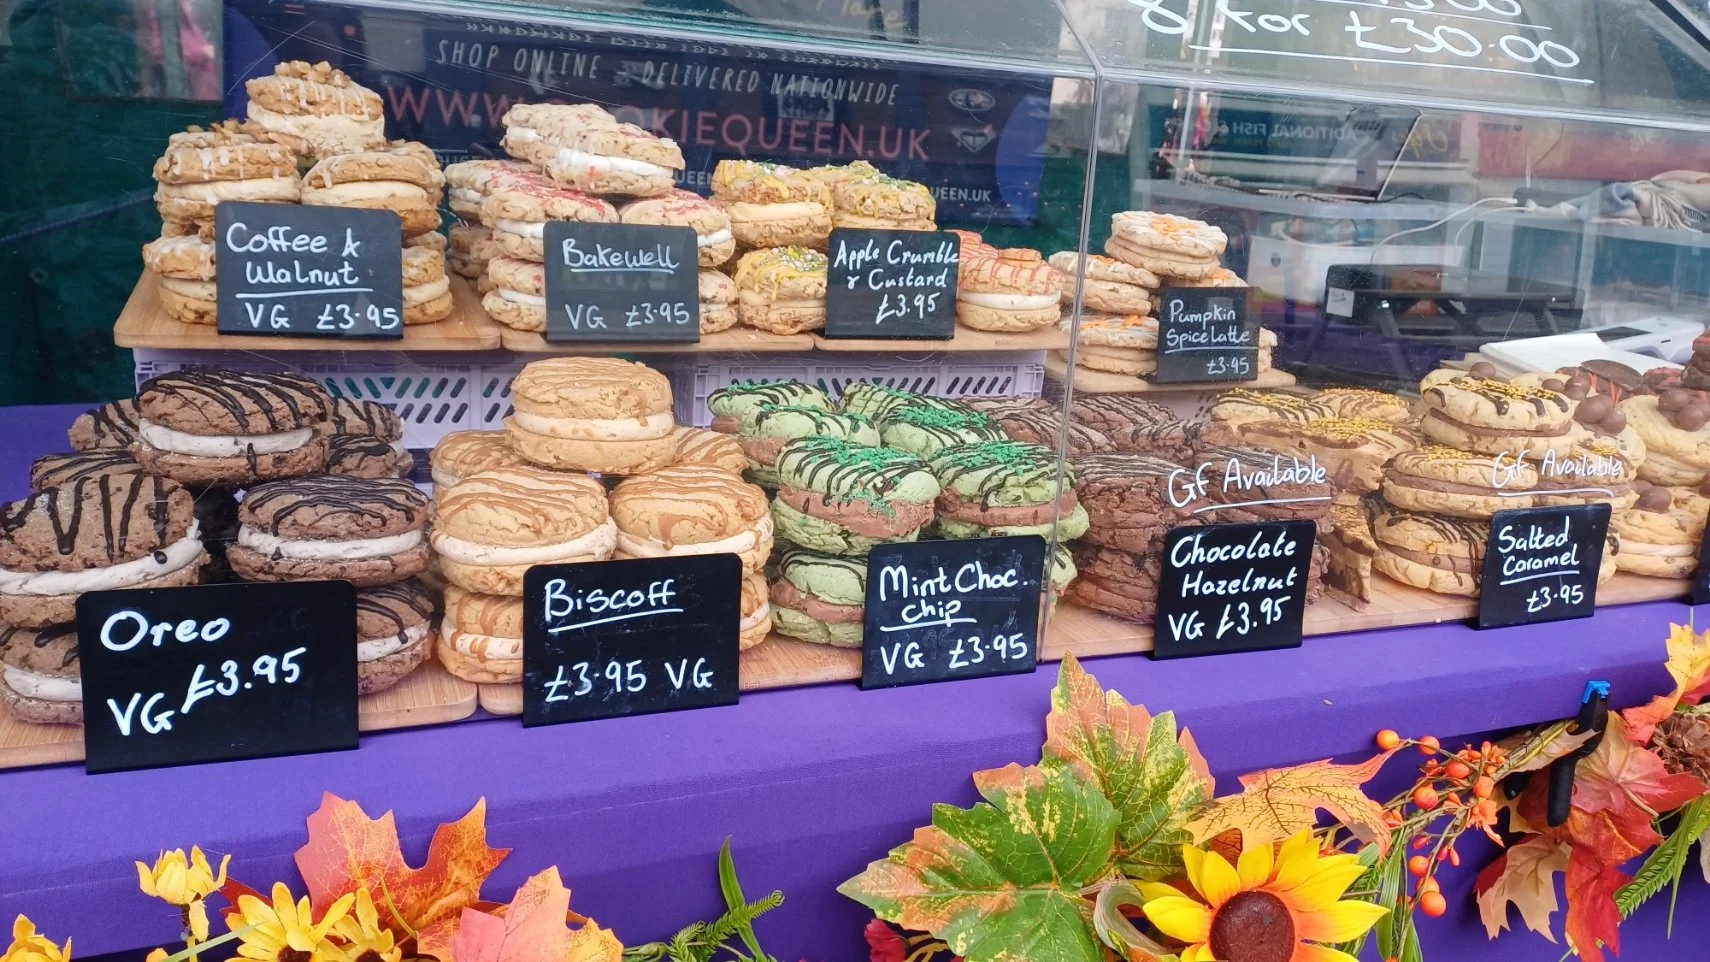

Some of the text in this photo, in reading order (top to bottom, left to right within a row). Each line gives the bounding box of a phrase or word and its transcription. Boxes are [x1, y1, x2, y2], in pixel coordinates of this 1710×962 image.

[1344, 10, 1580, 68] £30.00
[436, 39, 499, 68] SHOP
[513, 47, 600, 79] ONLINE
[642, 59, 760, 93] DELIVERED
[770, 72, 900, 106] NATIONWIDE
[226, 222, 328, 252] Coffee
[562, 238, 680, 269] Bakewell
[833, 238, 960, 271] Apple Crumble
[245, 260, 359, 286] Walnut
[868, 266, 948, 290] Custard
[245, 301, 400, 330] VG £3.95
[564, 302, 690, 330] VG £3.95
[875, 292, 941, 325] £3.95
[1169, 299, 1236, 330] Pumpkin
[1206, 356, 1250, 375] £3.95
[1223, 454, 1327, 493] Available
[1541, 448, 1623, 477] Available
[1170, 530, 1297, 568] Chocolate
[1497, 515, 1570, 553] Salted
[1502, 543, 1580, 576] Caramel
[879, 560, 1028, 601] Mint Choc.
[1181, 566, 1298, 598] Hazelnut
[544, 578, 676, 622] Biscoff
[1526, 584, 1584, 613] £3.95
[100, 610, 230, 651] Oreo
[1168, 595, 1292, 642] VG £3.95
[880, 632, 1028, 675] VG £3.95
[107, 646, 307, 736] VG £3.95
[544, 657, 714, 703] £3.95 VG
